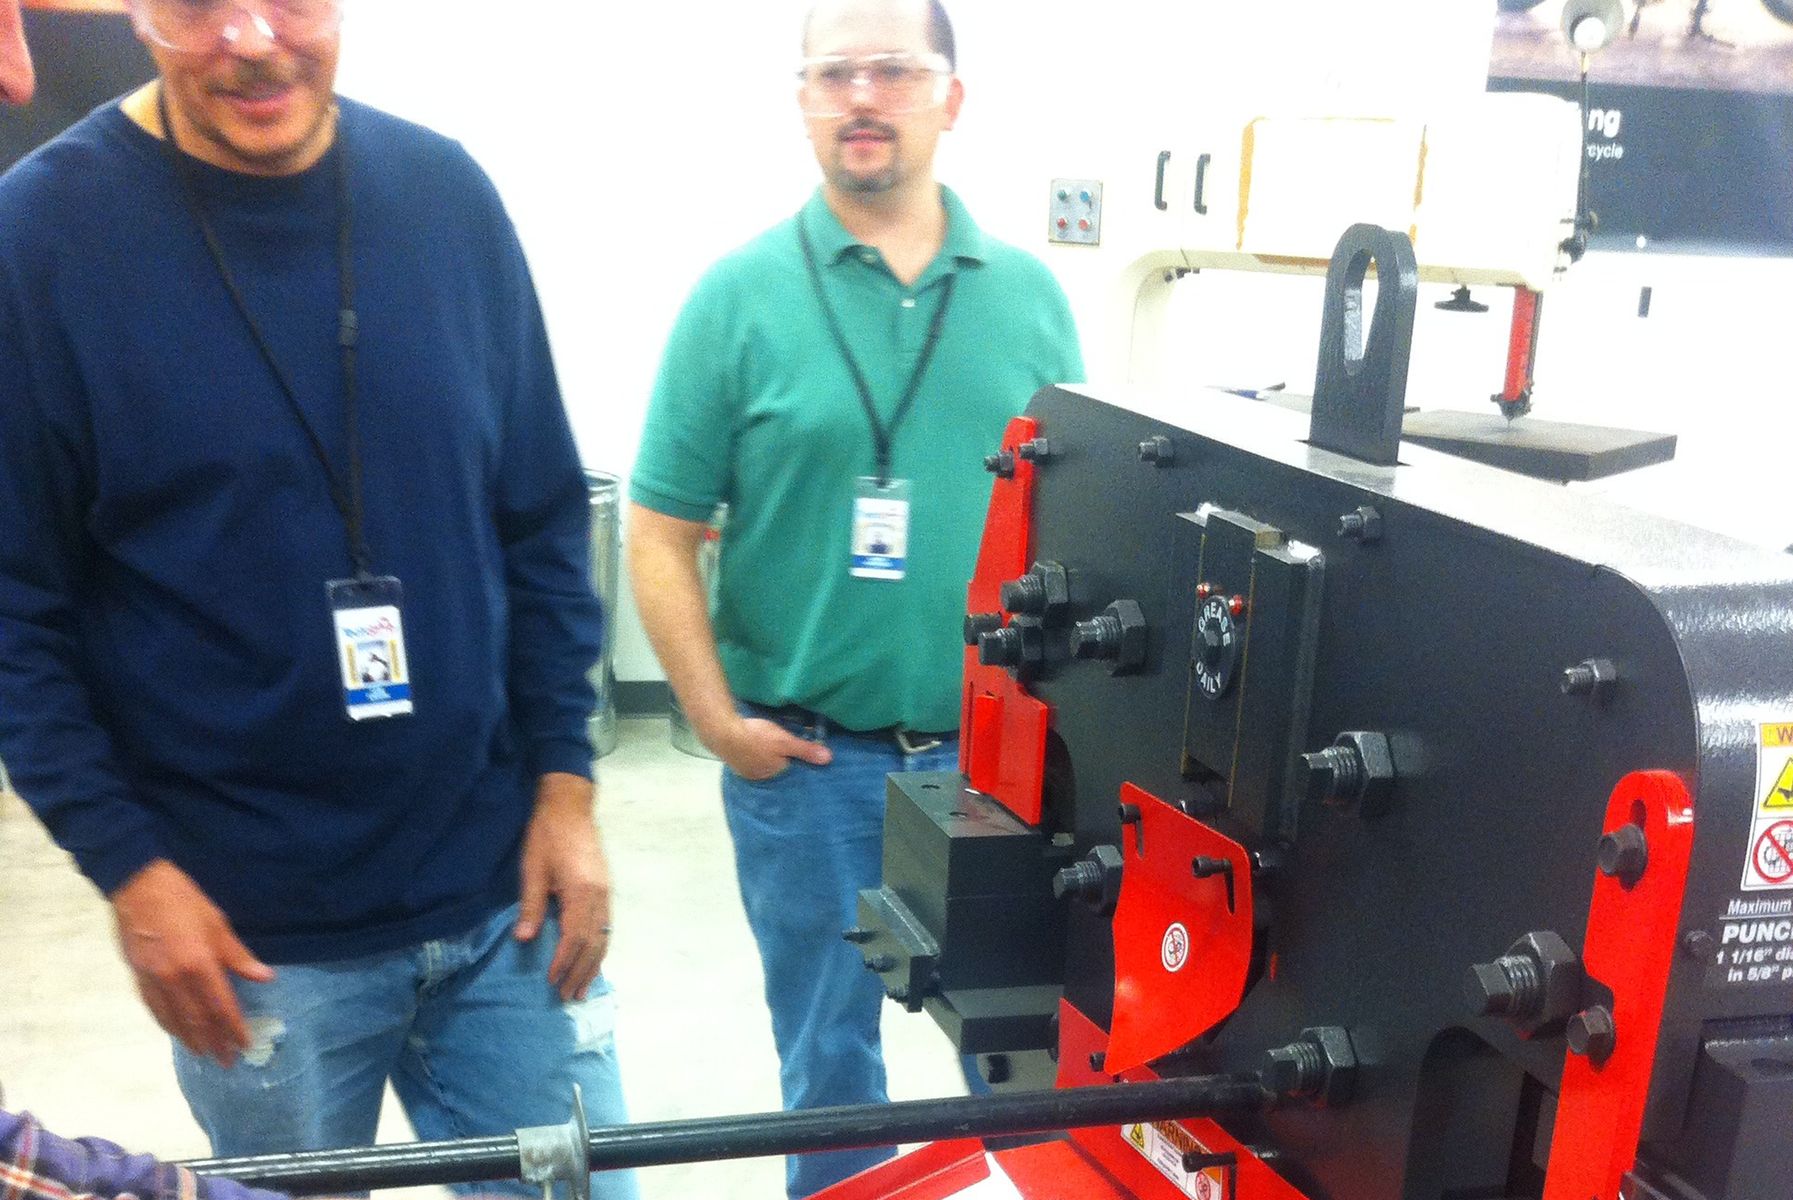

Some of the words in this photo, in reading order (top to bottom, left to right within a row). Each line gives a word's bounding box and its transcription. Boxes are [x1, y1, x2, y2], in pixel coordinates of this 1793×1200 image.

[1586, 108, 1621, 138] ng
[1196, 661, 1221, 693] DAILY
[1727, 898, 1792, 915] Maximum
[1721, 920, 1793, 945] PUNC
[1716, 949, 1725, 965] 1
[1727, 967, 1743, 982] in
